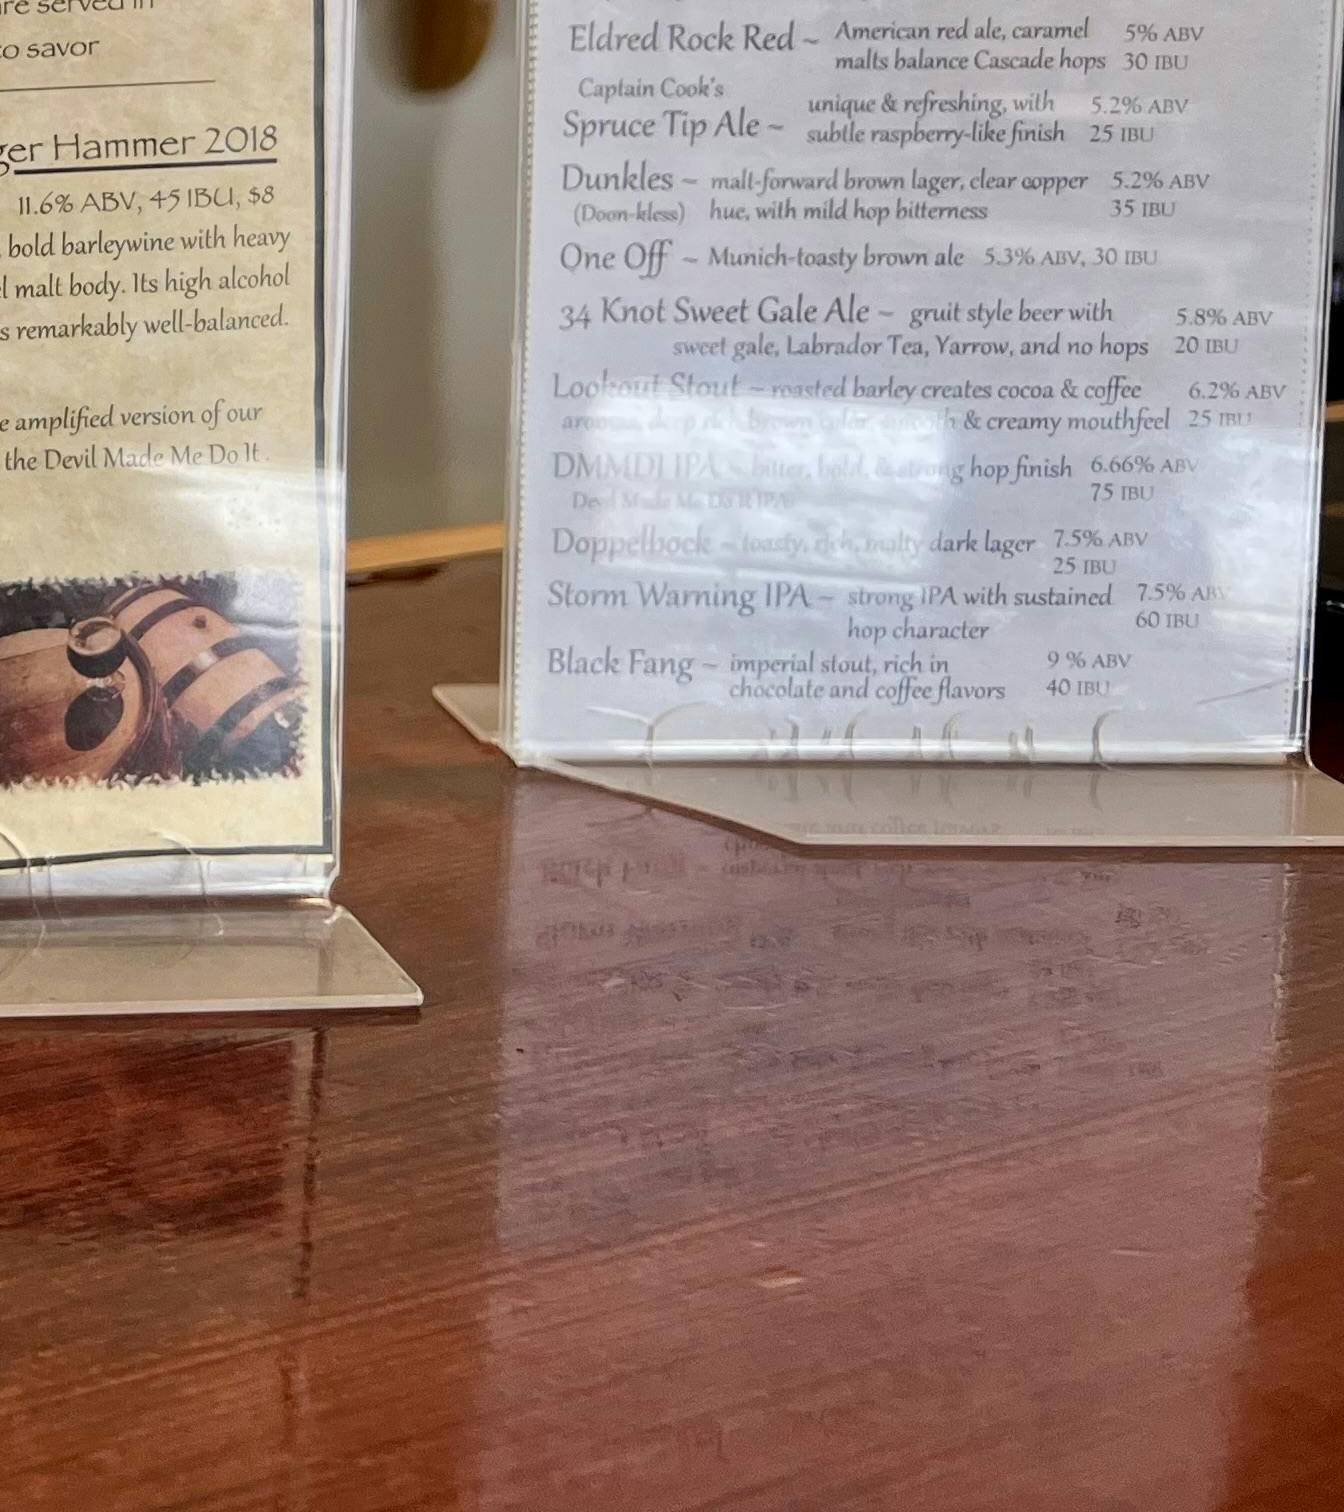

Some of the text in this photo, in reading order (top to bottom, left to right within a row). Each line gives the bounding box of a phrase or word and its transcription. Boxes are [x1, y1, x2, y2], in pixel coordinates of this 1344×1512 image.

[26, 40, 100, 59] savor
[570, 19, 795, 52] Eldred Rock Red
[578, 74, 725, 105] Captain Cook's
[53, 132, 196, 161] Hammer
[204, 124, 278, 155] 2018
[562, 107, 760, 148] Spruce Tip Ale
[562, 159, 674, 192] Dunkles
[18, 185, 275, 216] 11.6% ABV, 45 IBU, $8
[8, 231, 56, 259] bold
[61, 229, 175, 261] barleywine
[180, 224, 226, 250] with
[233, 223, 291, 254] heavy
[560, 238, 965, 279] One Off Munich-toasty brown ale
[559, 292, 870, 331] 34 Knot Sweet Gale Ale
[547, 579, 813, 619] Storm Warning IPA
[546, 645, 696, 686] Black Fang
